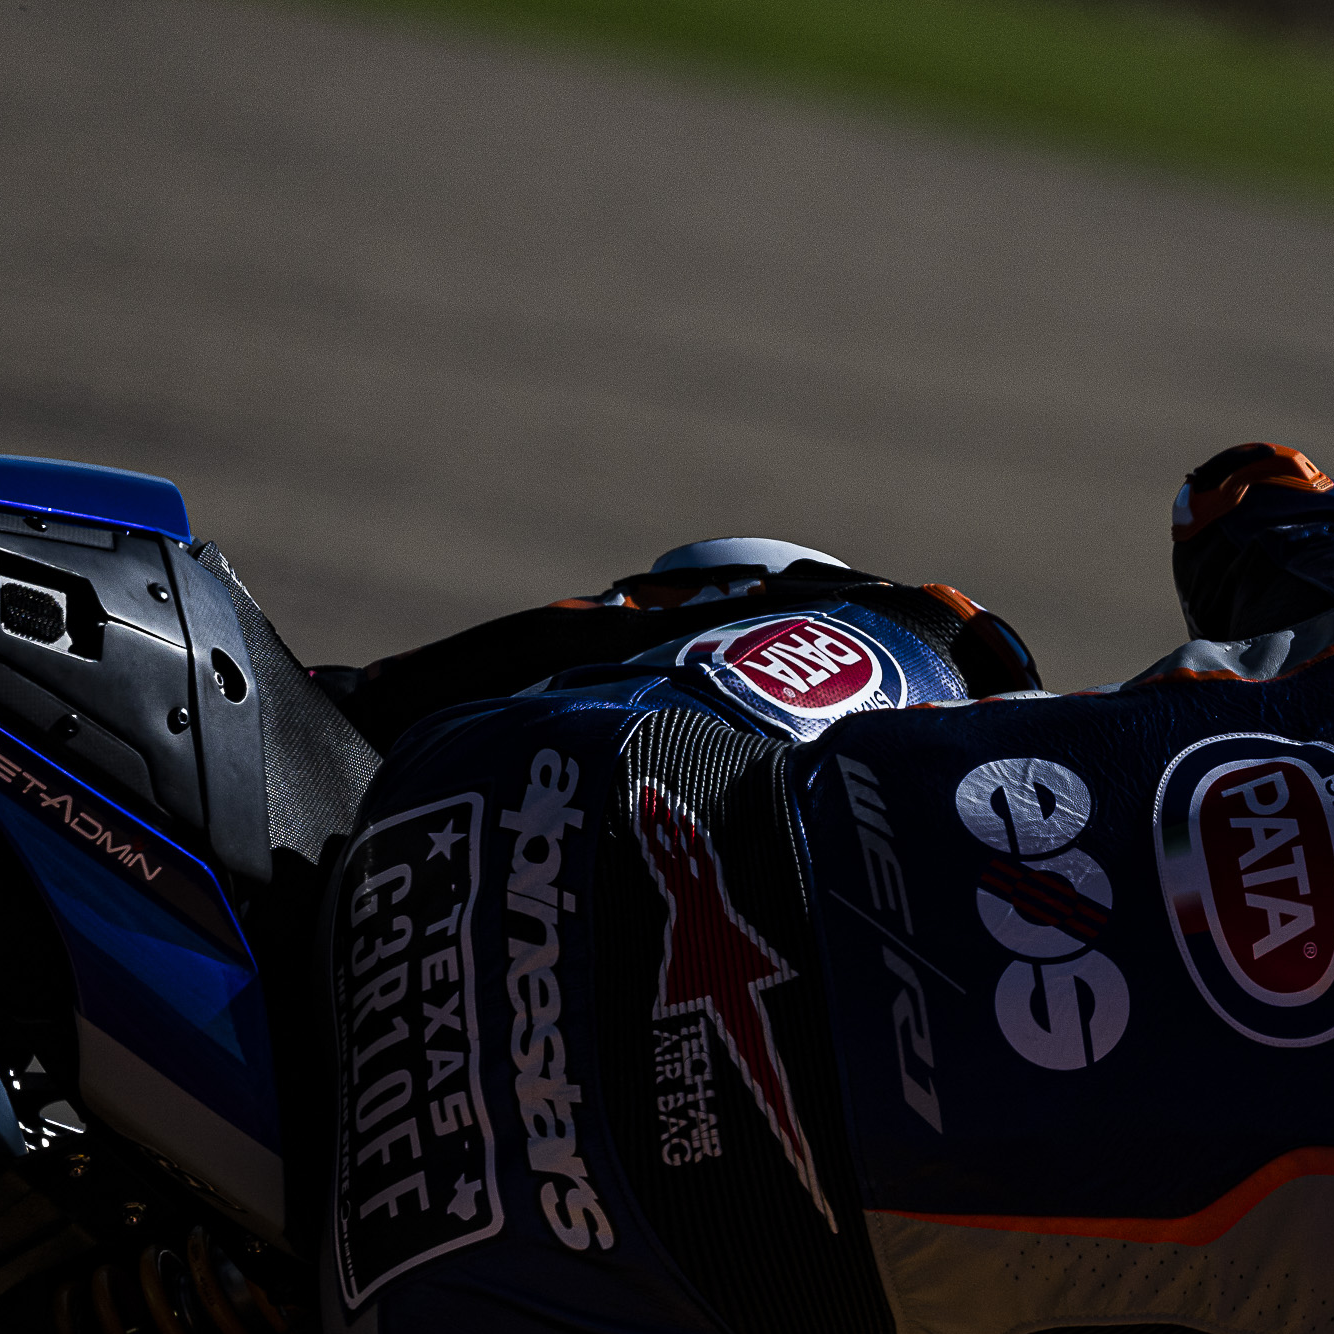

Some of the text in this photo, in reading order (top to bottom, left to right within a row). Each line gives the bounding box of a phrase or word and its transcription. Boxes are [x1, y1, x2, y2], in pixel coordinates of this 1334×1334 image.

[746, 620, 864, 695] PATA
[1220, 769, 1317, 961] PATA
[420, 904, 474, 1138] TEXAS
[498, 746, 616, 1253] alpinestars
[652, 1028, 693, 1167] AIR BAG
